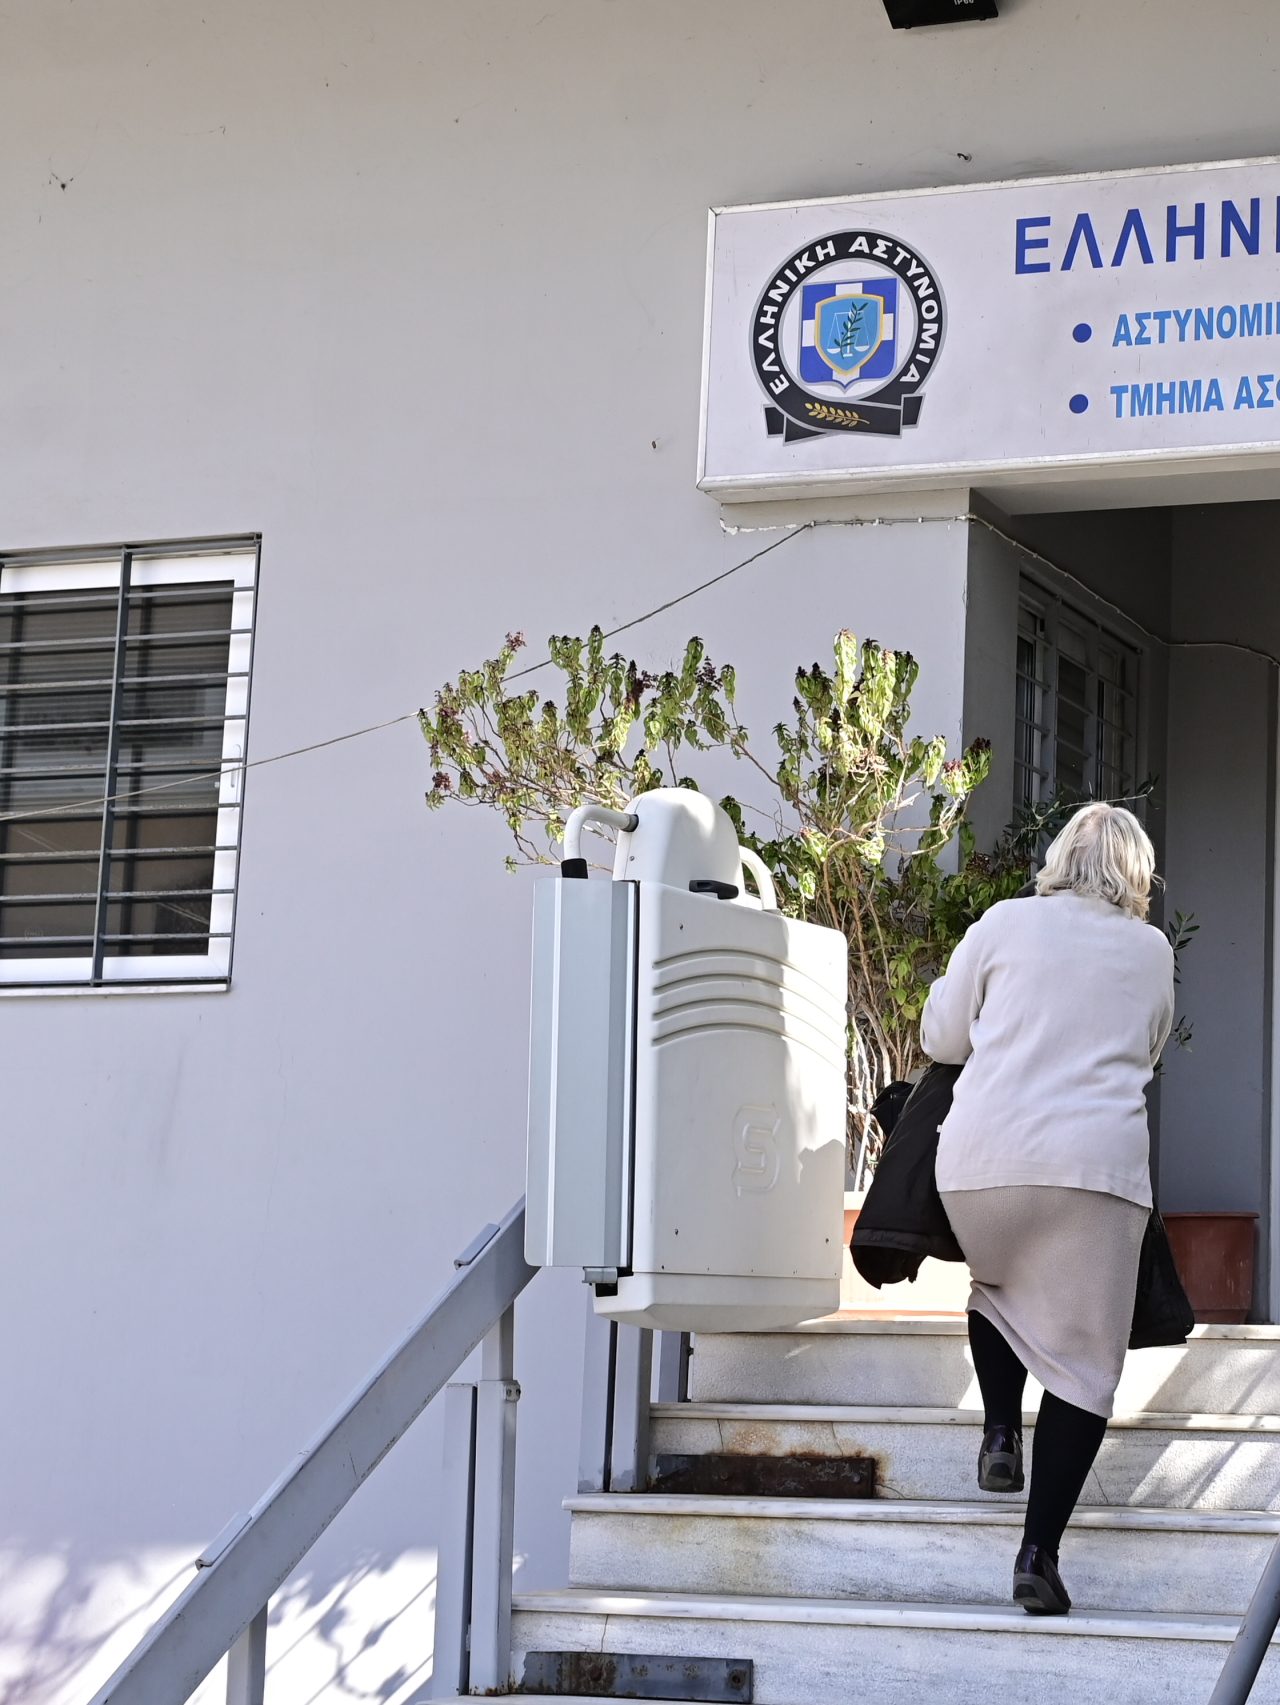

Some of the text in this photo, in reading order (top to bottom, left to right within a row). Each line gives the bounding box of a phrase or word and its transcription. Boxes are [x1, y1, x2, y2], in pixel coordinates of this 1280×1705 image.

[758, 235, 939, 395] ΕΛΛΗΝΙΚΗ ΑΣΤΥΝΟΜΙΑ
[1110, 377, 1225, 418] ΤΜΗΜΑ
